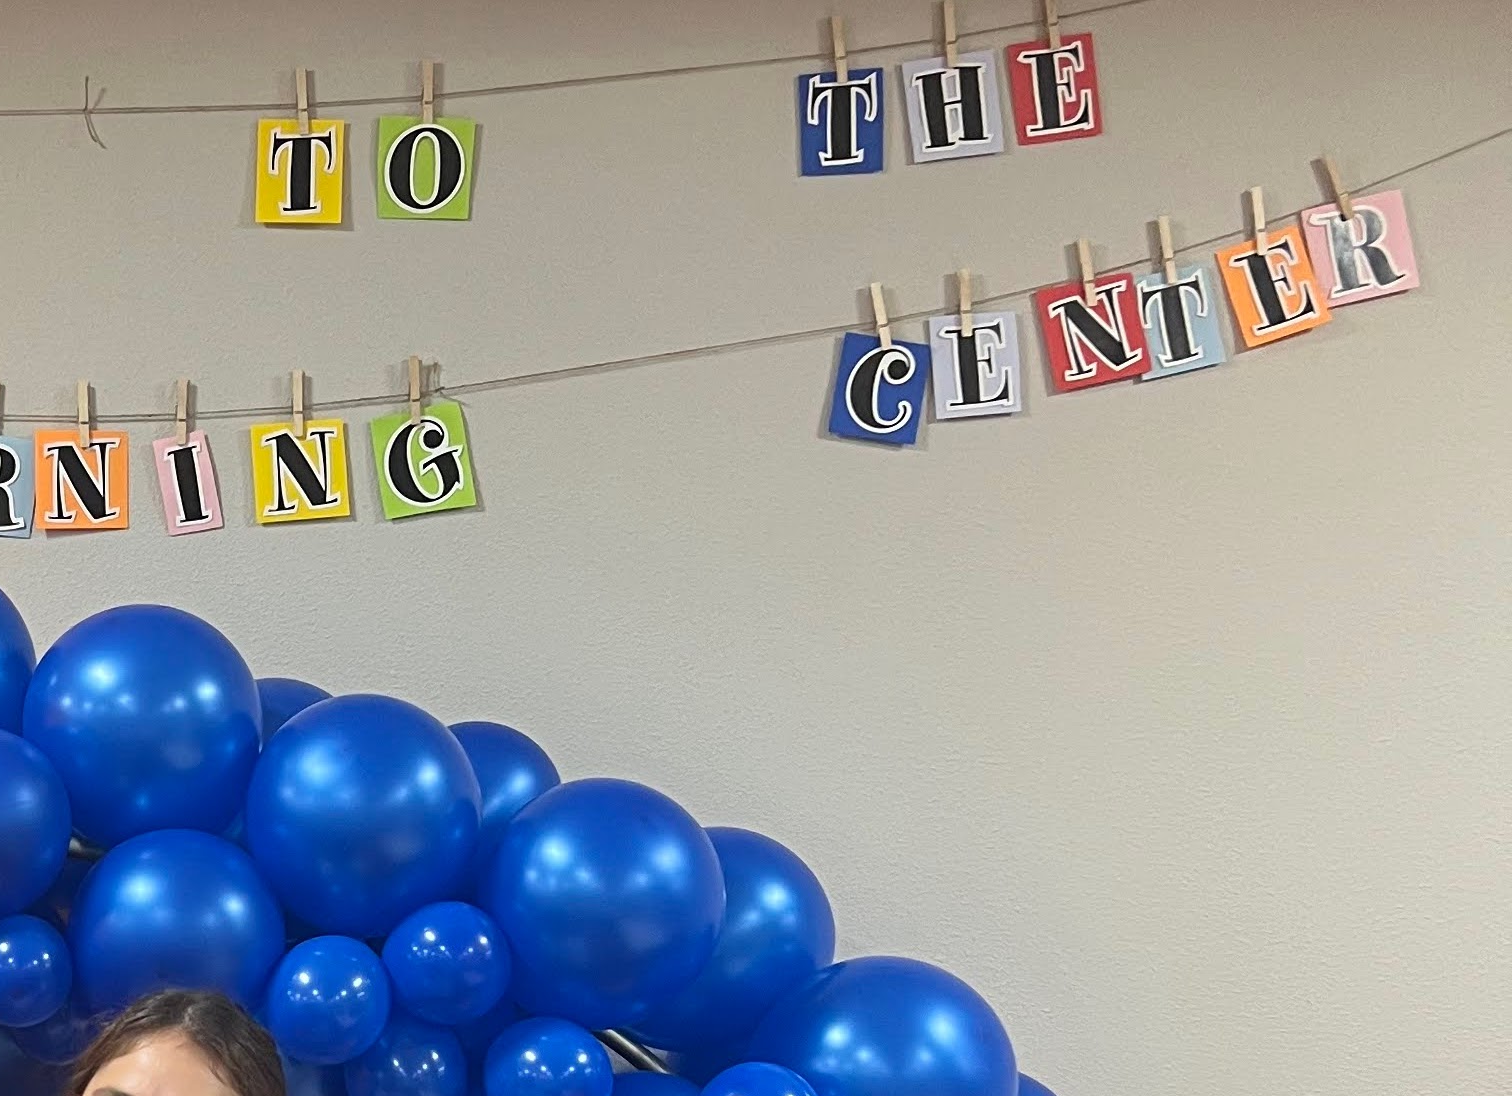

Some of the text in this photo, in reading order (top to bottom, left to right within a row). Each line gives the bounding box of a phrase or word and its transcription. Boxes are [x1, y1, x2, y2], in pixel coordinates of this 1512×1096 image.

[268, 124, 466, 215] TO
[807, 40, 1092, 166] THE
[844, 204, 1412, 434] CENTER
